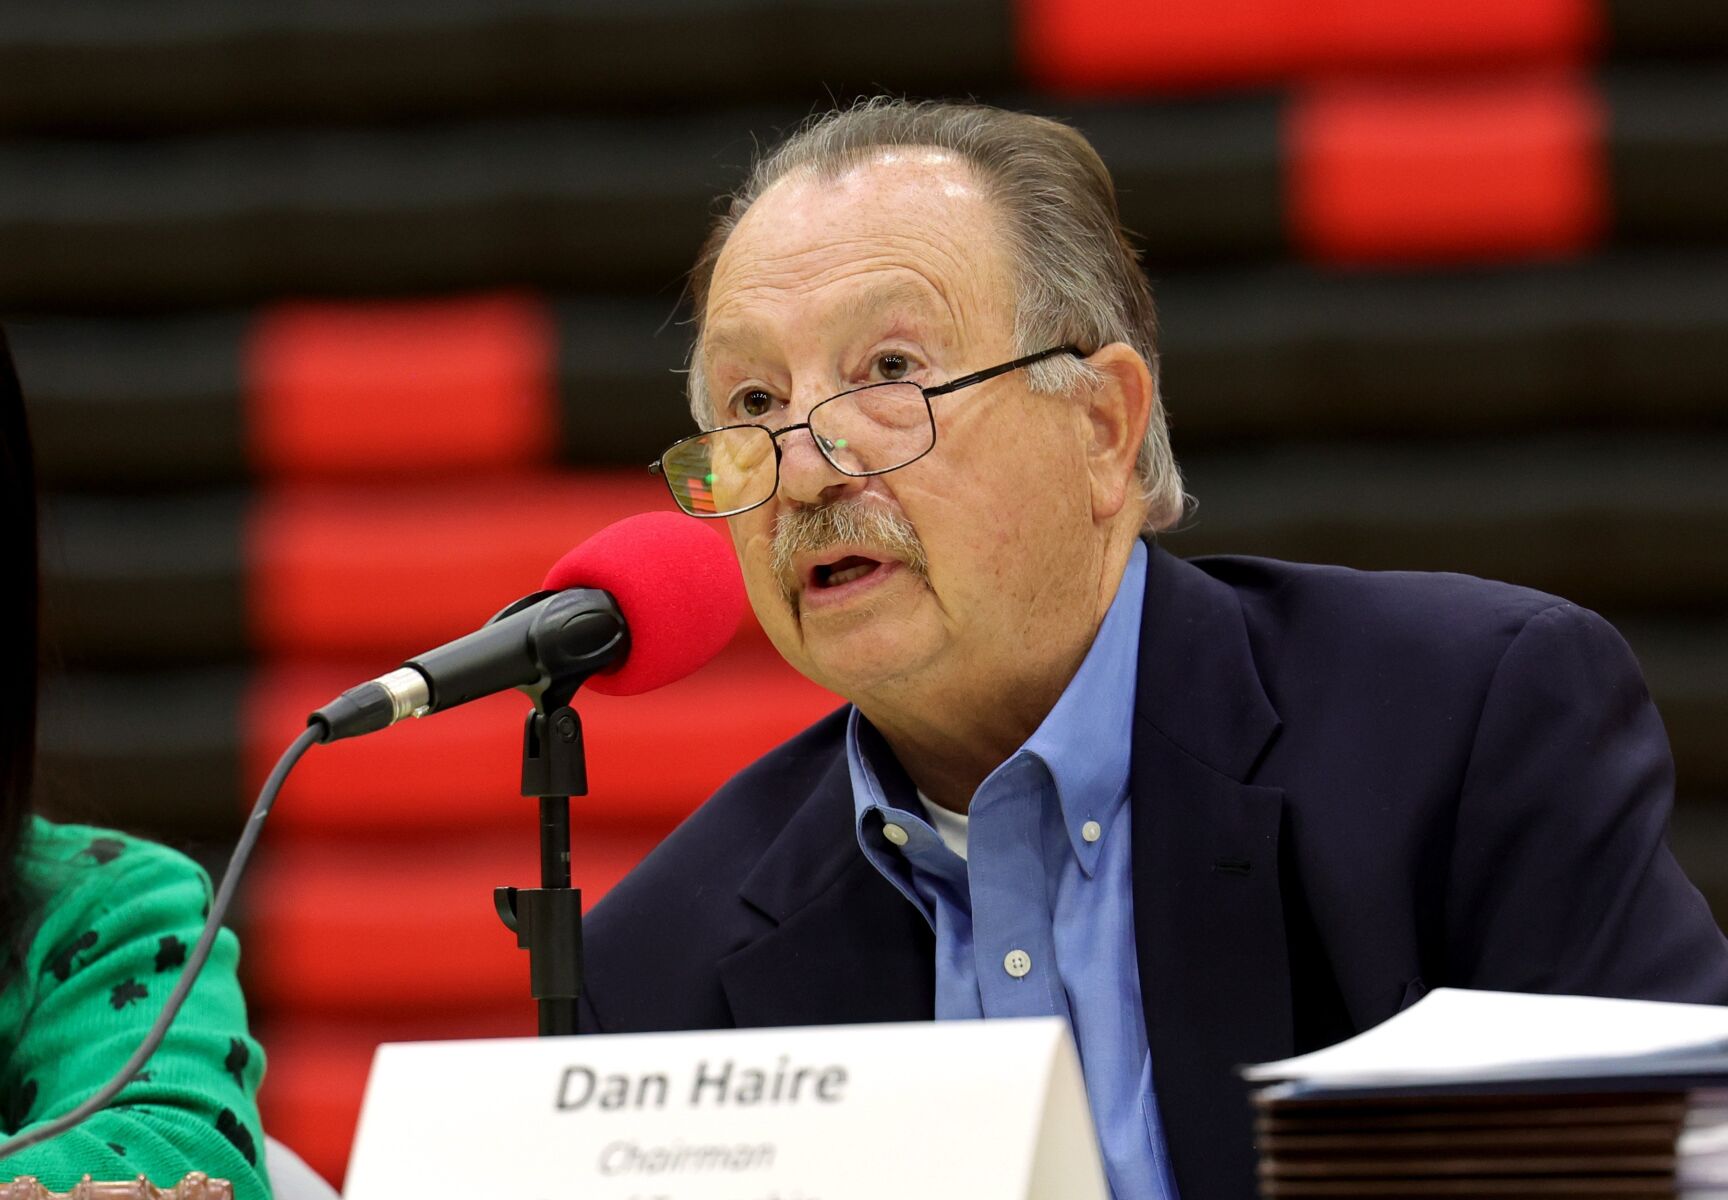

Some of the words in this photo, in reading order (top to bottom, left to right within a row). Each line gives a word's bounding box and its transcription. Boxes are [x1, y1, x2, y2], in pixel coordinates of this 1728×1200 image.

[555, 1064, 669, 1112] Dan
[688, 1054, 848, 1106] Haire
[598, 1139, 776, 1175] Chairman
